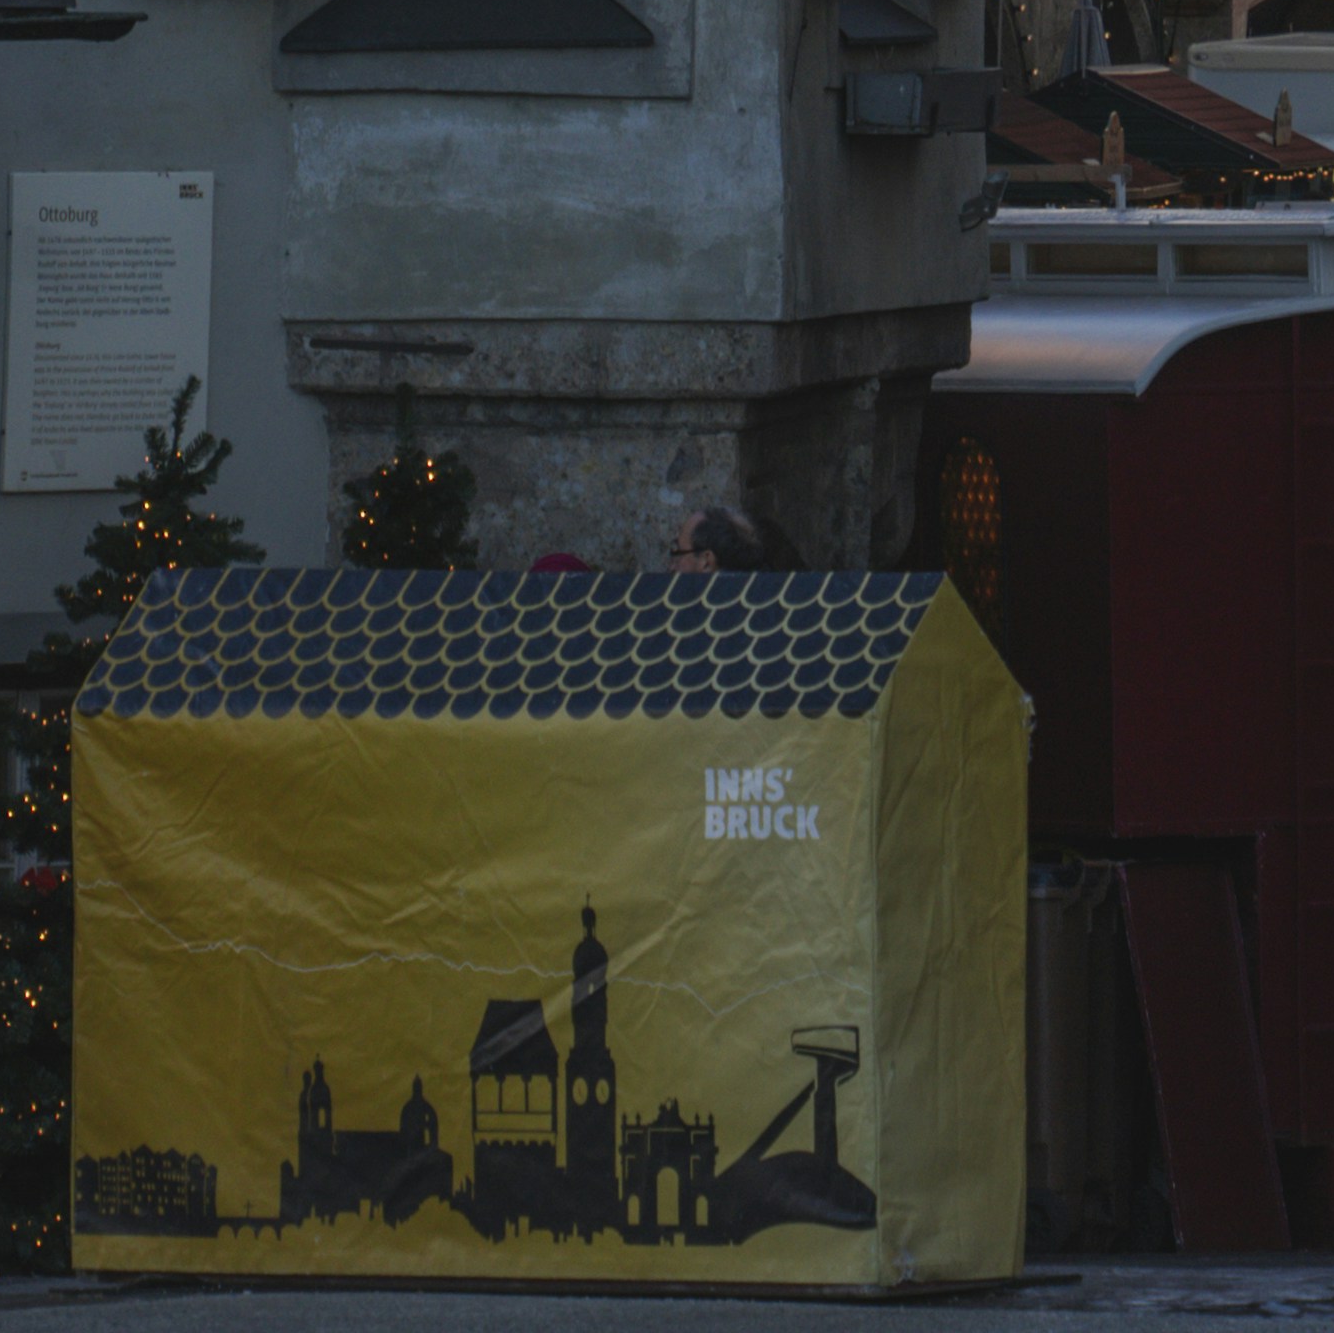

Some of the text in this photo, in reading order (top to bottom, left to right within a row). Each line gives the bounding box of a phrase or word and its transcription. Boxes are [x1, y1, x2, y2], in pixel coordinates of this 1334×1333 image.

[38, 206, 99, 228] Ottoburg
[705, 767, 793, 803] INNS'
[705, 804, 820, 840] BRUCK
